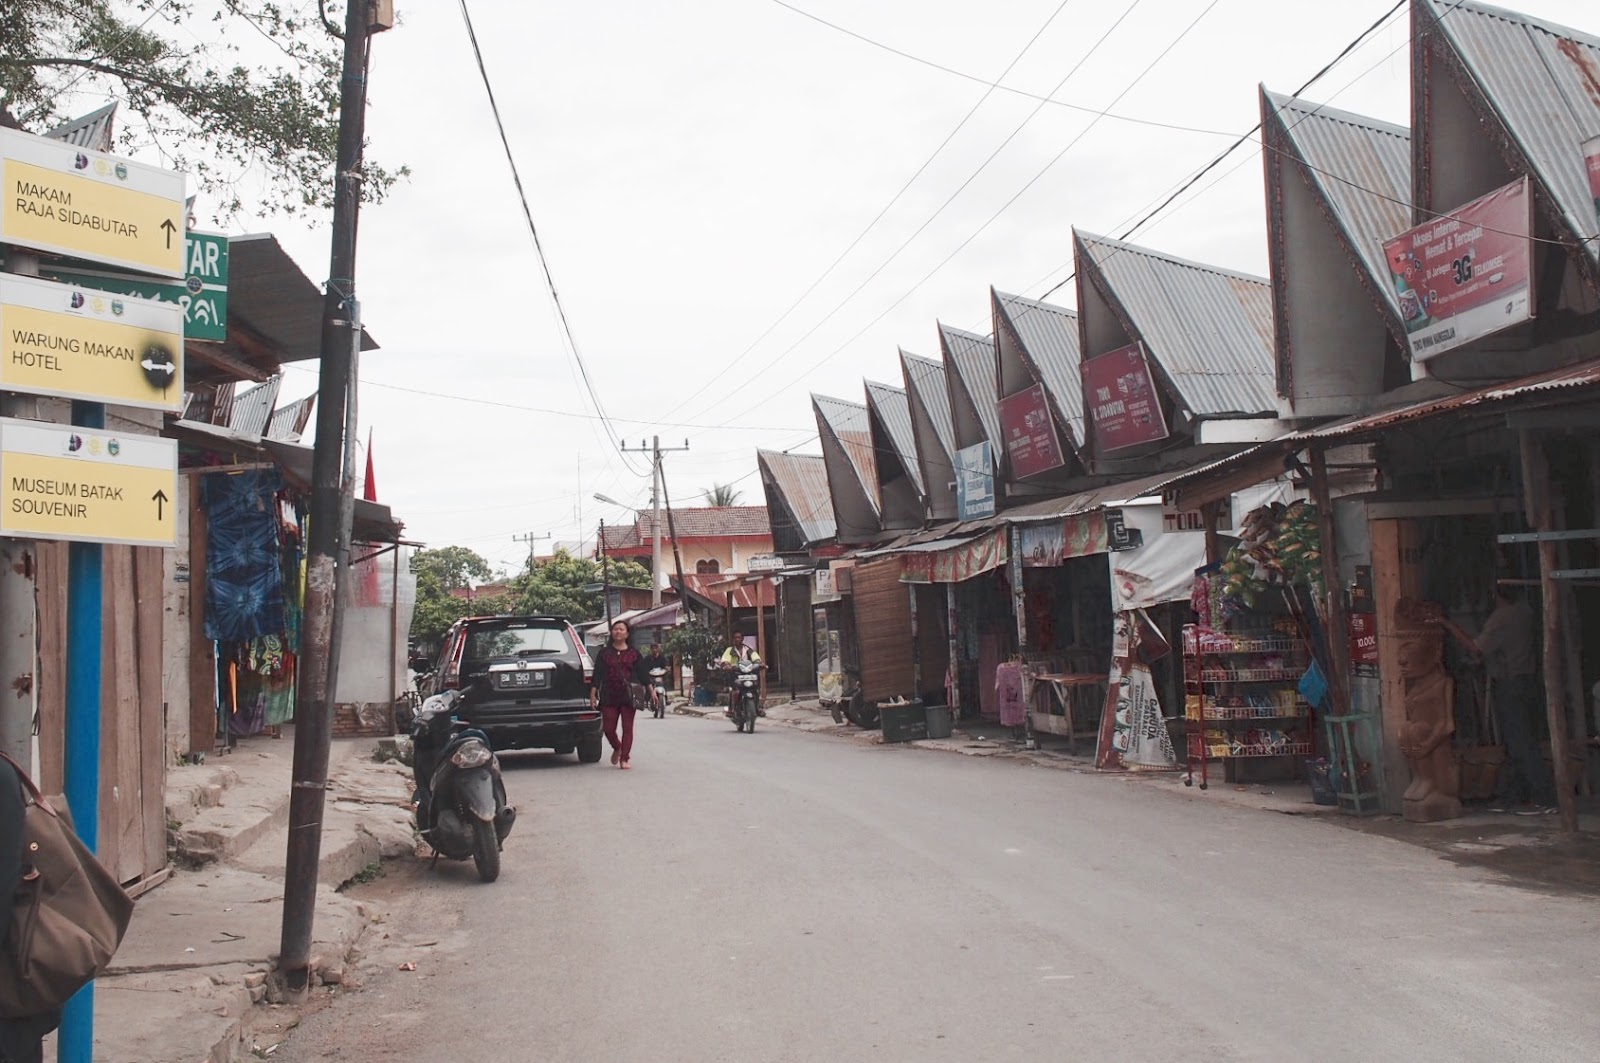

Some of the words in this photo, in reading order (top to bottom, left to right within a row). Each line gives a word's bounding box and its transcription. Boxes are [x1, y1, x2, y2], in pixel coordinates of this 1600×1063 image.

[16, 180, 72, 206] MAKAM
[16, 199, 55, 221] RAJA
[58, 207, 138, 239] SIDABUTAR
[1452, 254, 1473, 286] 3G
[12, 330, 80, 354] WARUNG
[84, 341, 134, 361] MAKAN
[12, 351, 63, 372] HOTEL
[12, 477, 77, 498] MUSEUM
[81, 484, 123, 502] BATAK
[12, 499, 87, 519] SOUVENIR
[1164, 513, 1226, 530] TOILT
[1147, 698, 1158, 740] GARUDA
